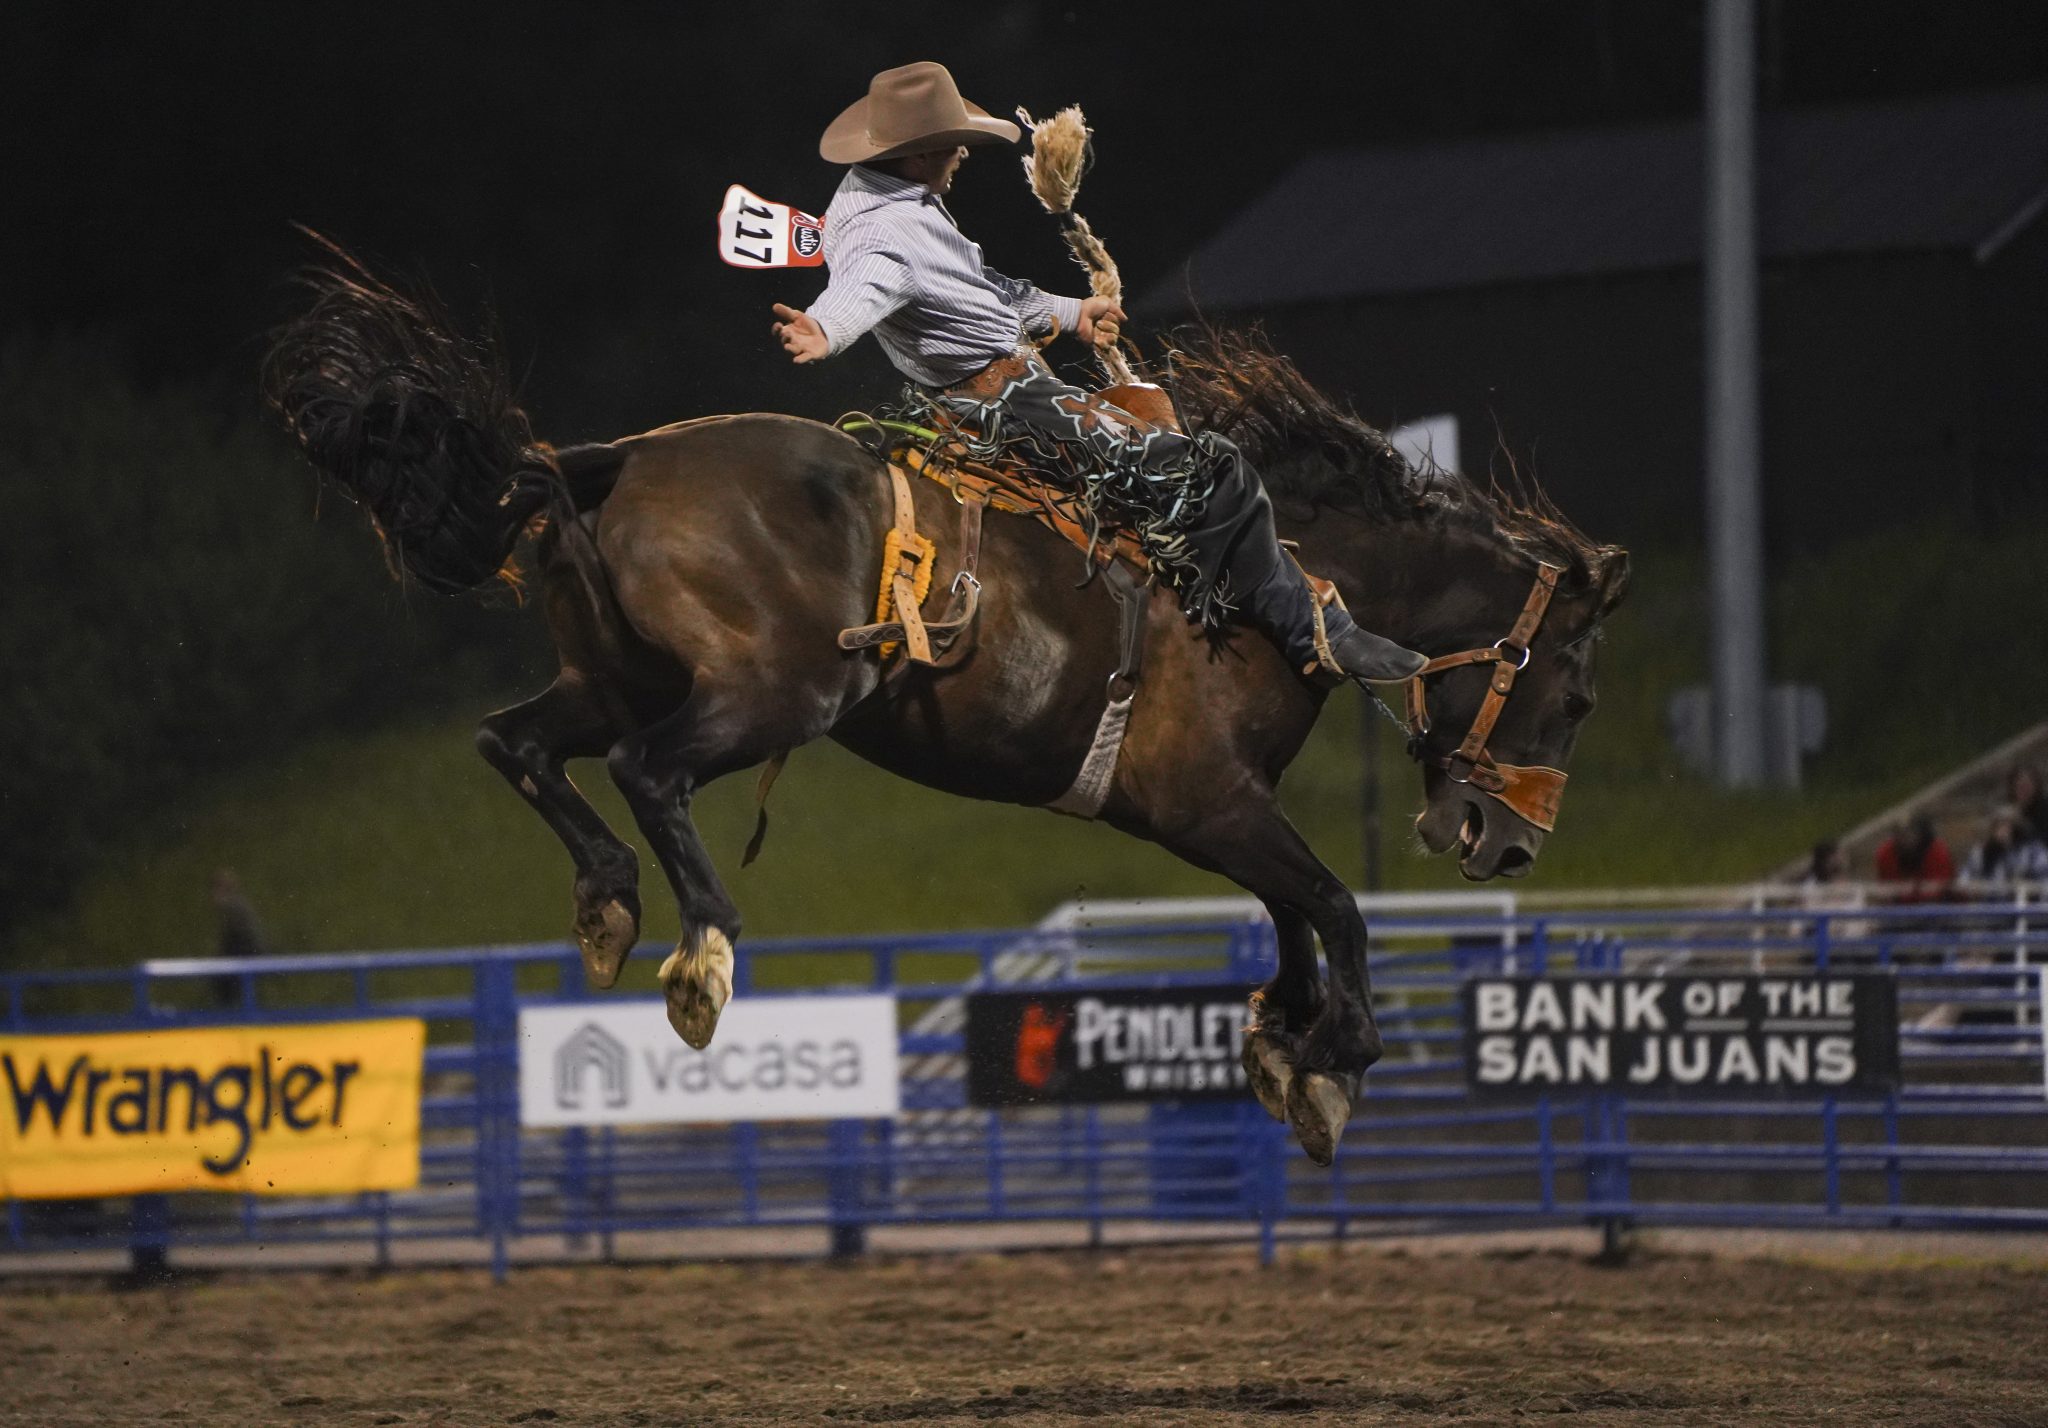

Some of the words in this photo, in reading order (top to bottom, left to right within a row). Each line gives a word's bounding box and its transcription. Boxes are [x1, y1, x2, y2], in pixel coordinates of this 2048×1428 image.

[734, 196, 774, 264] 117
[1073, 998, 1252, 1068] PENDLET
[1475, 982, 1668, 1031] BANK
[1683, 982, 1747, 1017] OF
[1760, 982, 1854, 1016] THE
[644, 1040, 864, 1093] vacasa
[1477, 1034, 1610, 1083] SAN
[1628, 1035, 1857, 1083] JUANS
[2, 1045, 360, 1175] Wrangler
